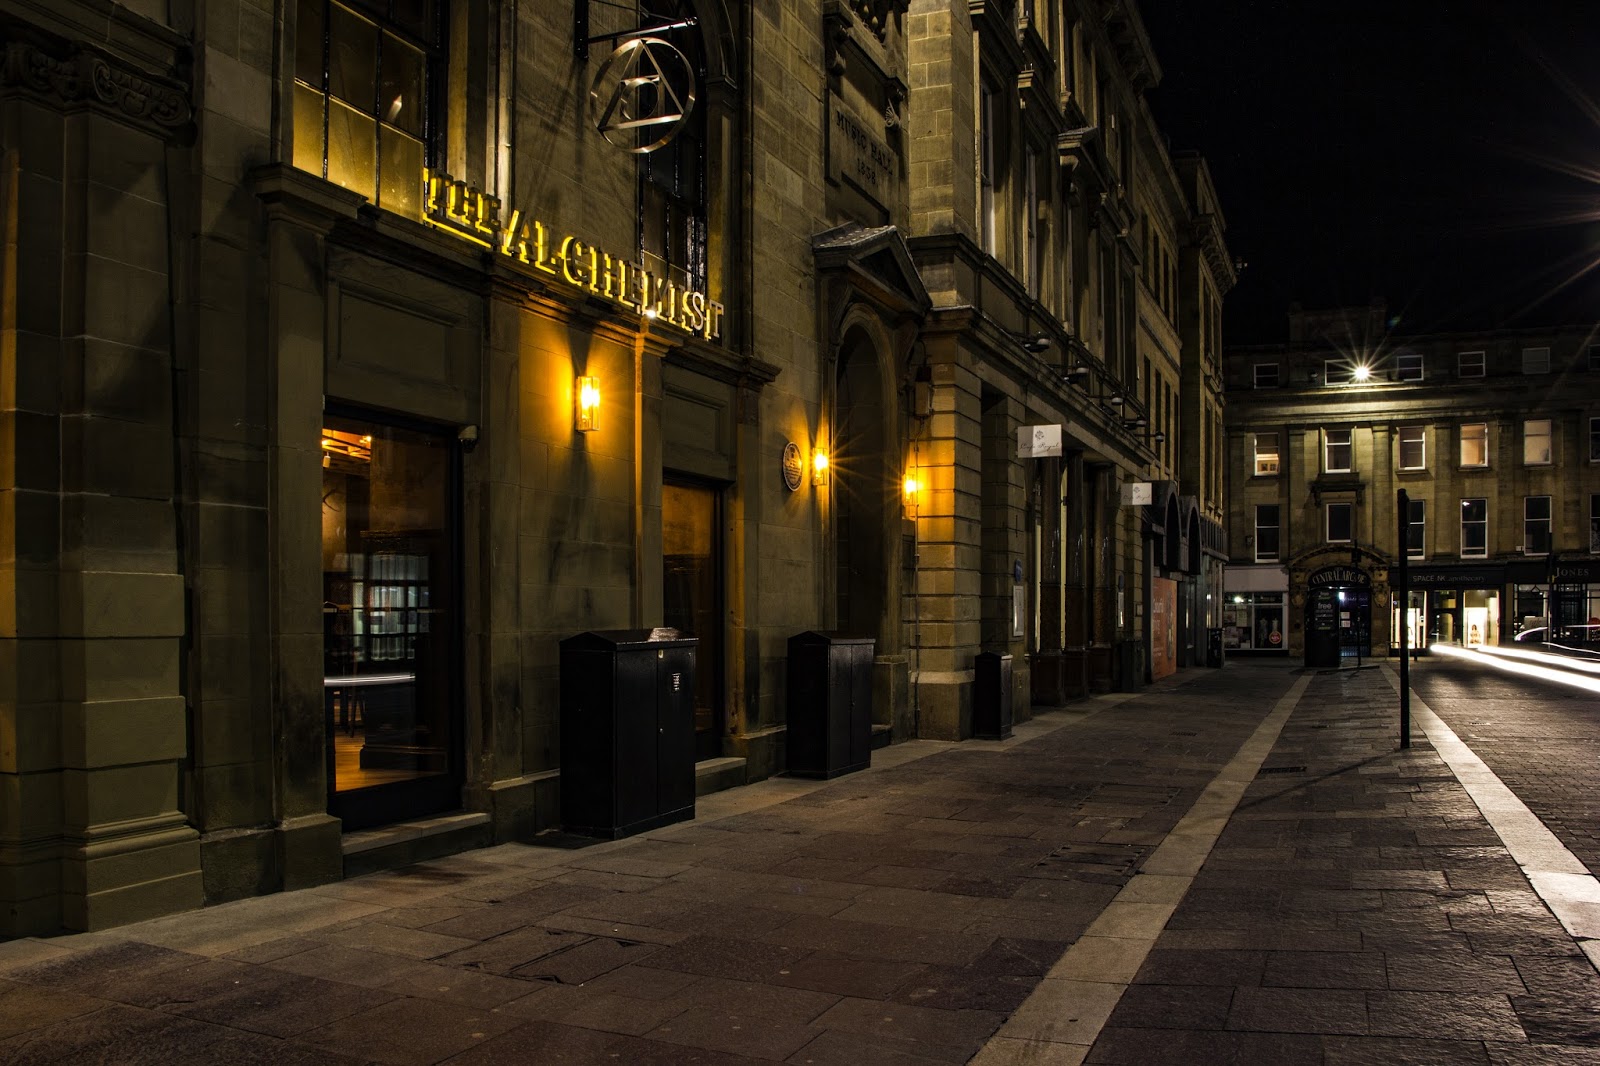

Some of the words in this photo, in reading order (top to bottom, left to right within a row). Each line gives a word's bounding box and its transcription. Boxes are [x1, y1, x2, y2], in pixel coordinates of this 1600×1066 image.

[836, 110, 867, 150] MUSIC
[870, 142, 893, 176] HALL
[423, 167, 501, 236] THE
[501, 208, 725, 342] ALCHEMIST
[1311, 570, 1340, 584] CENTRAL
[1555, 567, 1590, 579] JONES
